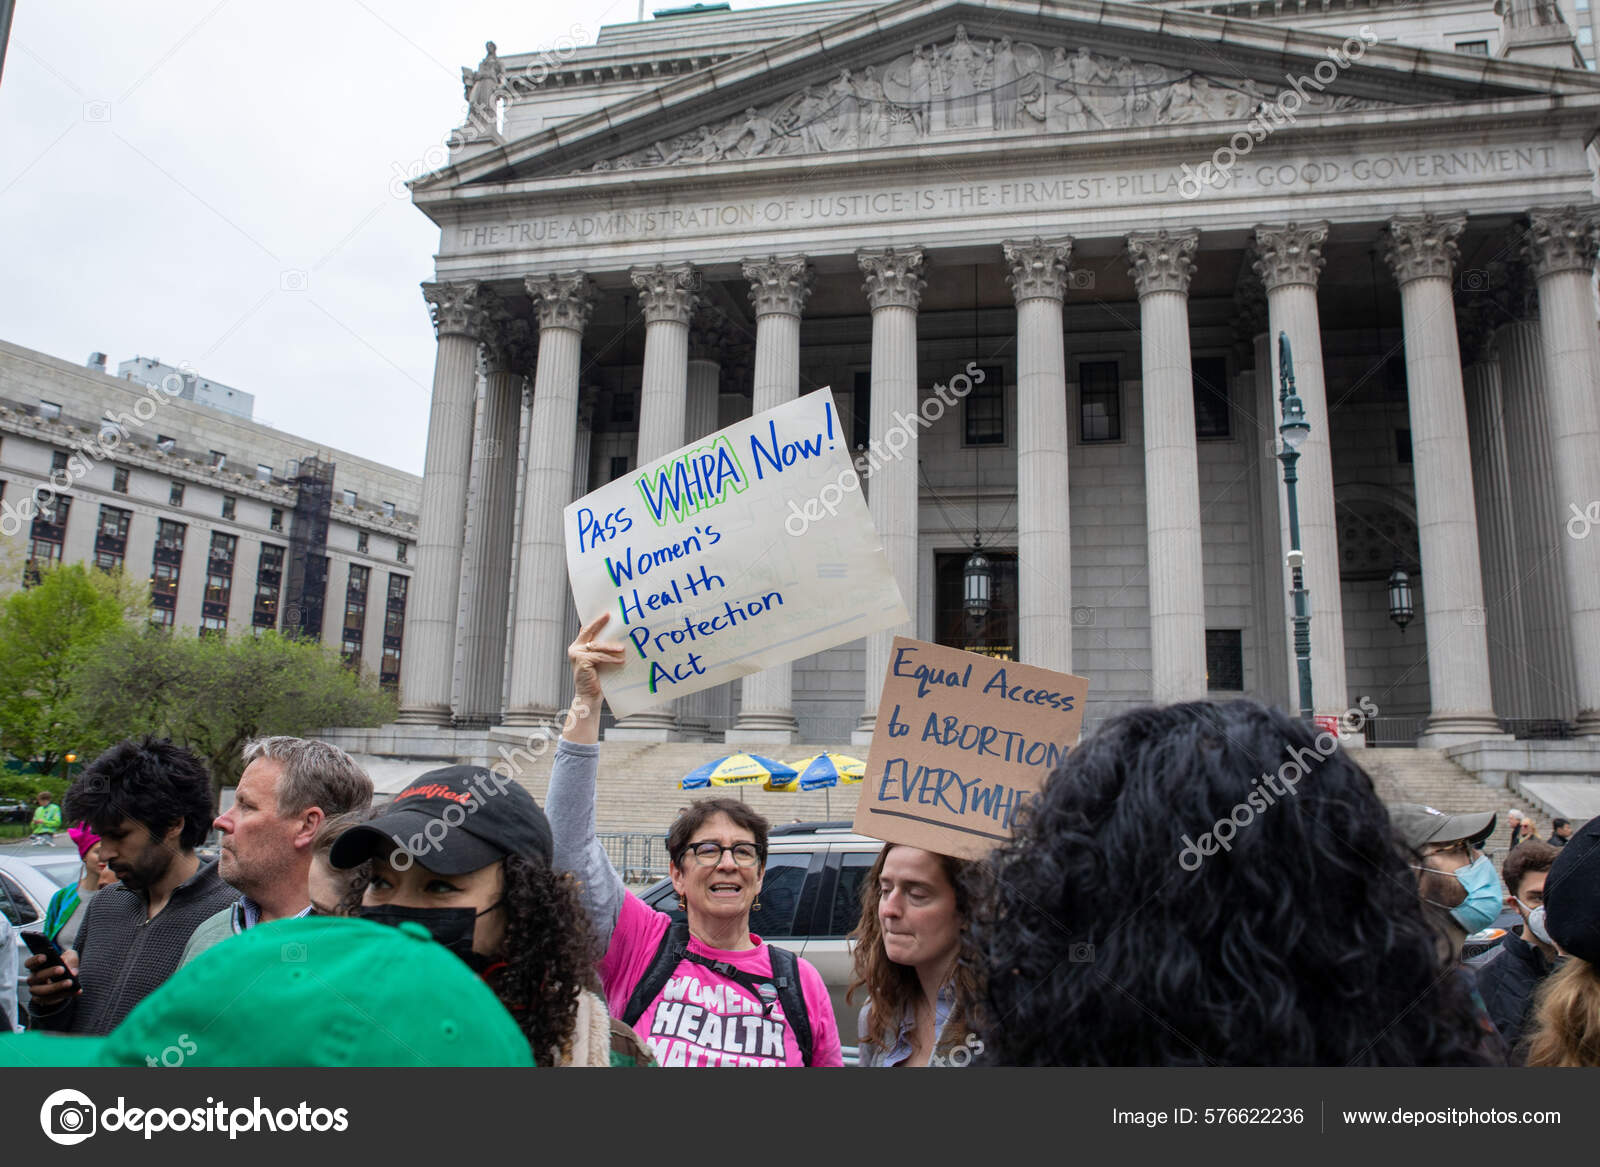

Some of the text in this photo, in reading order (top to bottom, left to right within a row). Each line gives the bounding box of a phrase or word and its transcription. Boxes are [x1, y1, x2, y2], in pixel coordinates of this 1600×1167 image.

[462, 226, 499, 247] THE
[507, 222, 559, 243] TRUE
[566, 204, 756, 239] ADMINISTRATION
[765, 201, 796, 222] OF
[803, 193, 907, 219] JUSTICE
[914, 190, 936, 211] IS
[943, 186, 990, 208] THE
[1001, 177, 1106, 205] FIRMEST
[1256, 162, 1339, 187] GOOD
[1353, 146, 1554, 182] GOVERNMENT
[638, 442, 743, 523] WHPA
[750, 401, 835, 480] Now!
[604, 524, 722, 587] Women's
[618, 565, 726, 625] Health
[629, 591, 784, 659] Protection
[649, 652, 706, 694] Act
[893, 647, 1075, 712] Equal Access
[888, 704, 1070, 769] to ABORTION
[877, 758, 1032, 830] EVERYWHE
[652, 1002, 784, 1057] HEALTH
